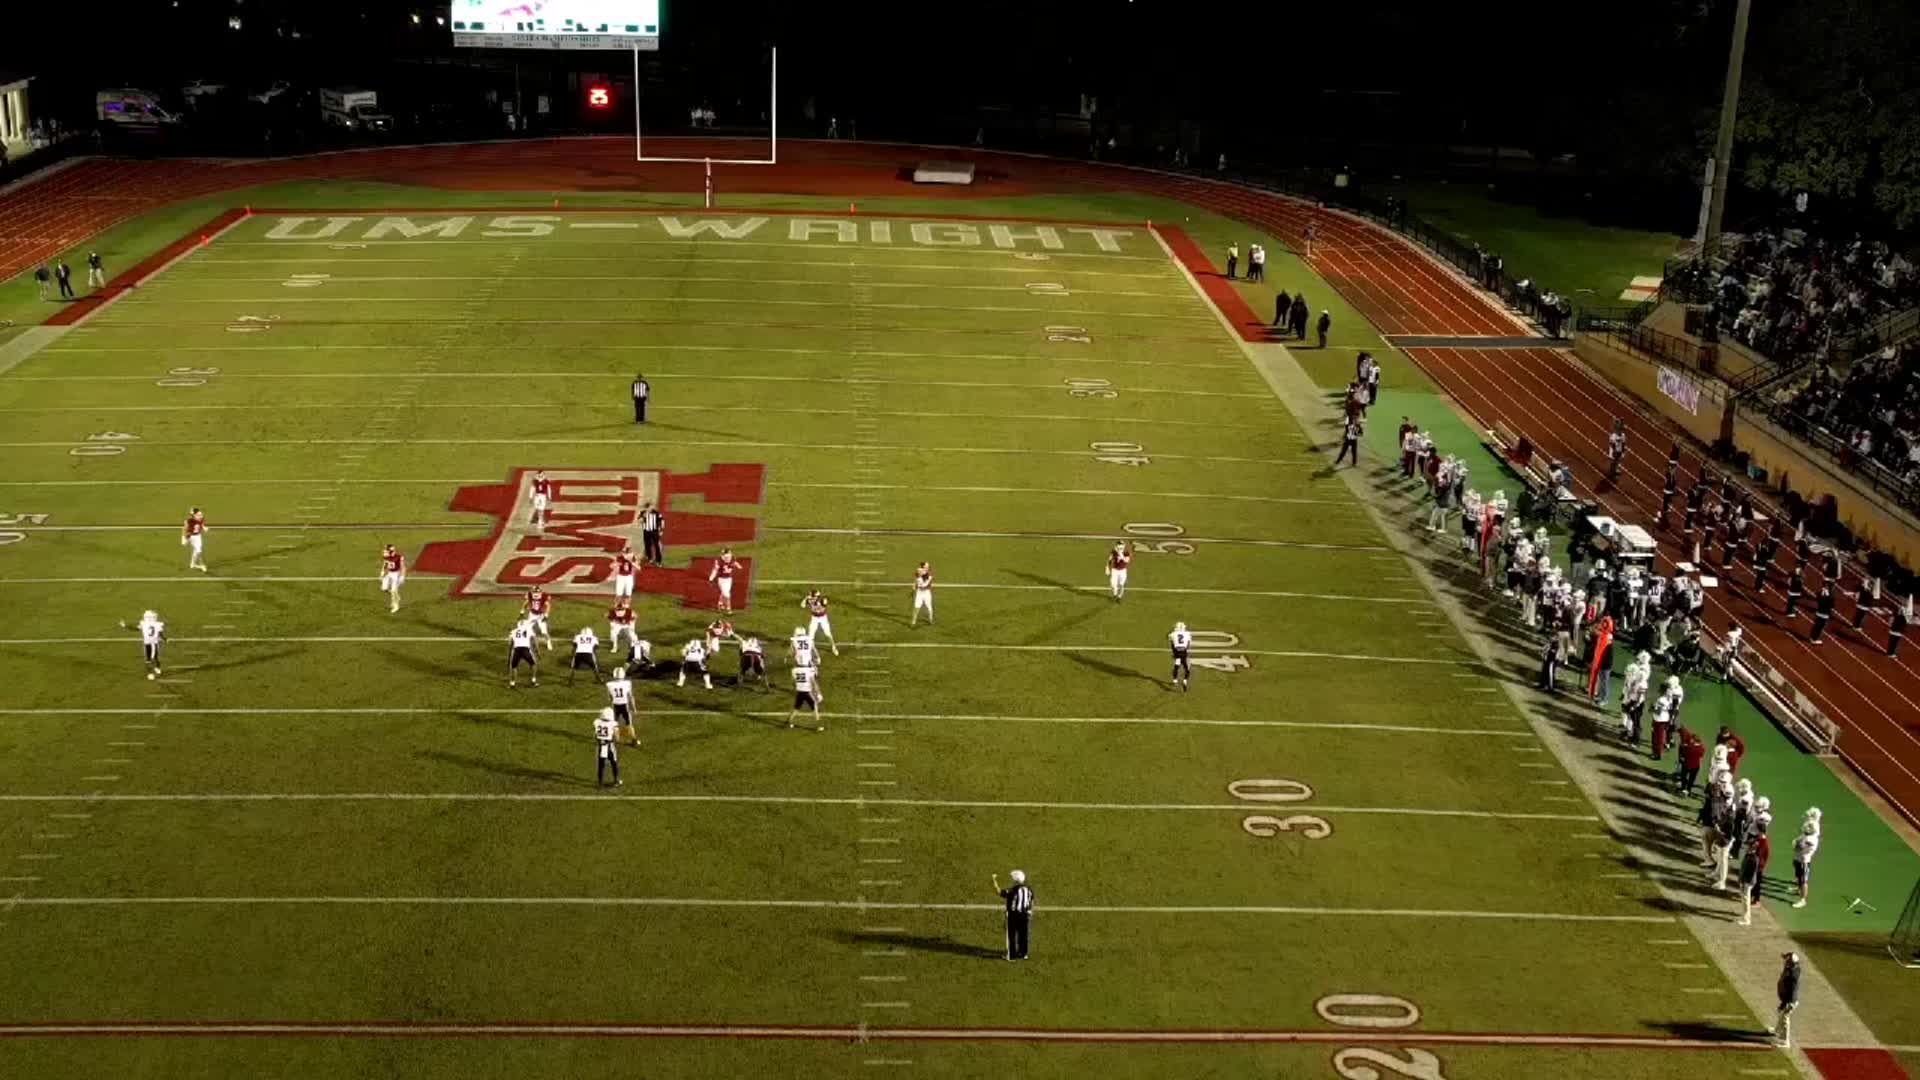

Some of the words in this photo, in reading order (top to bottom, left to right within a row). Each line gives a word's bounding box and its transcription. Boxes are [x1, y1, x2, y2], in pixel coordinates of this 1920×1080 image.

[1062, 376, 1120, 399] 30
[1088, 440, 1152, 467] 40
[1122, 522, 1196, 555] 50
[1227, 777, 1334, 840] 30
[1314, 993, 1448, 1080] 20
